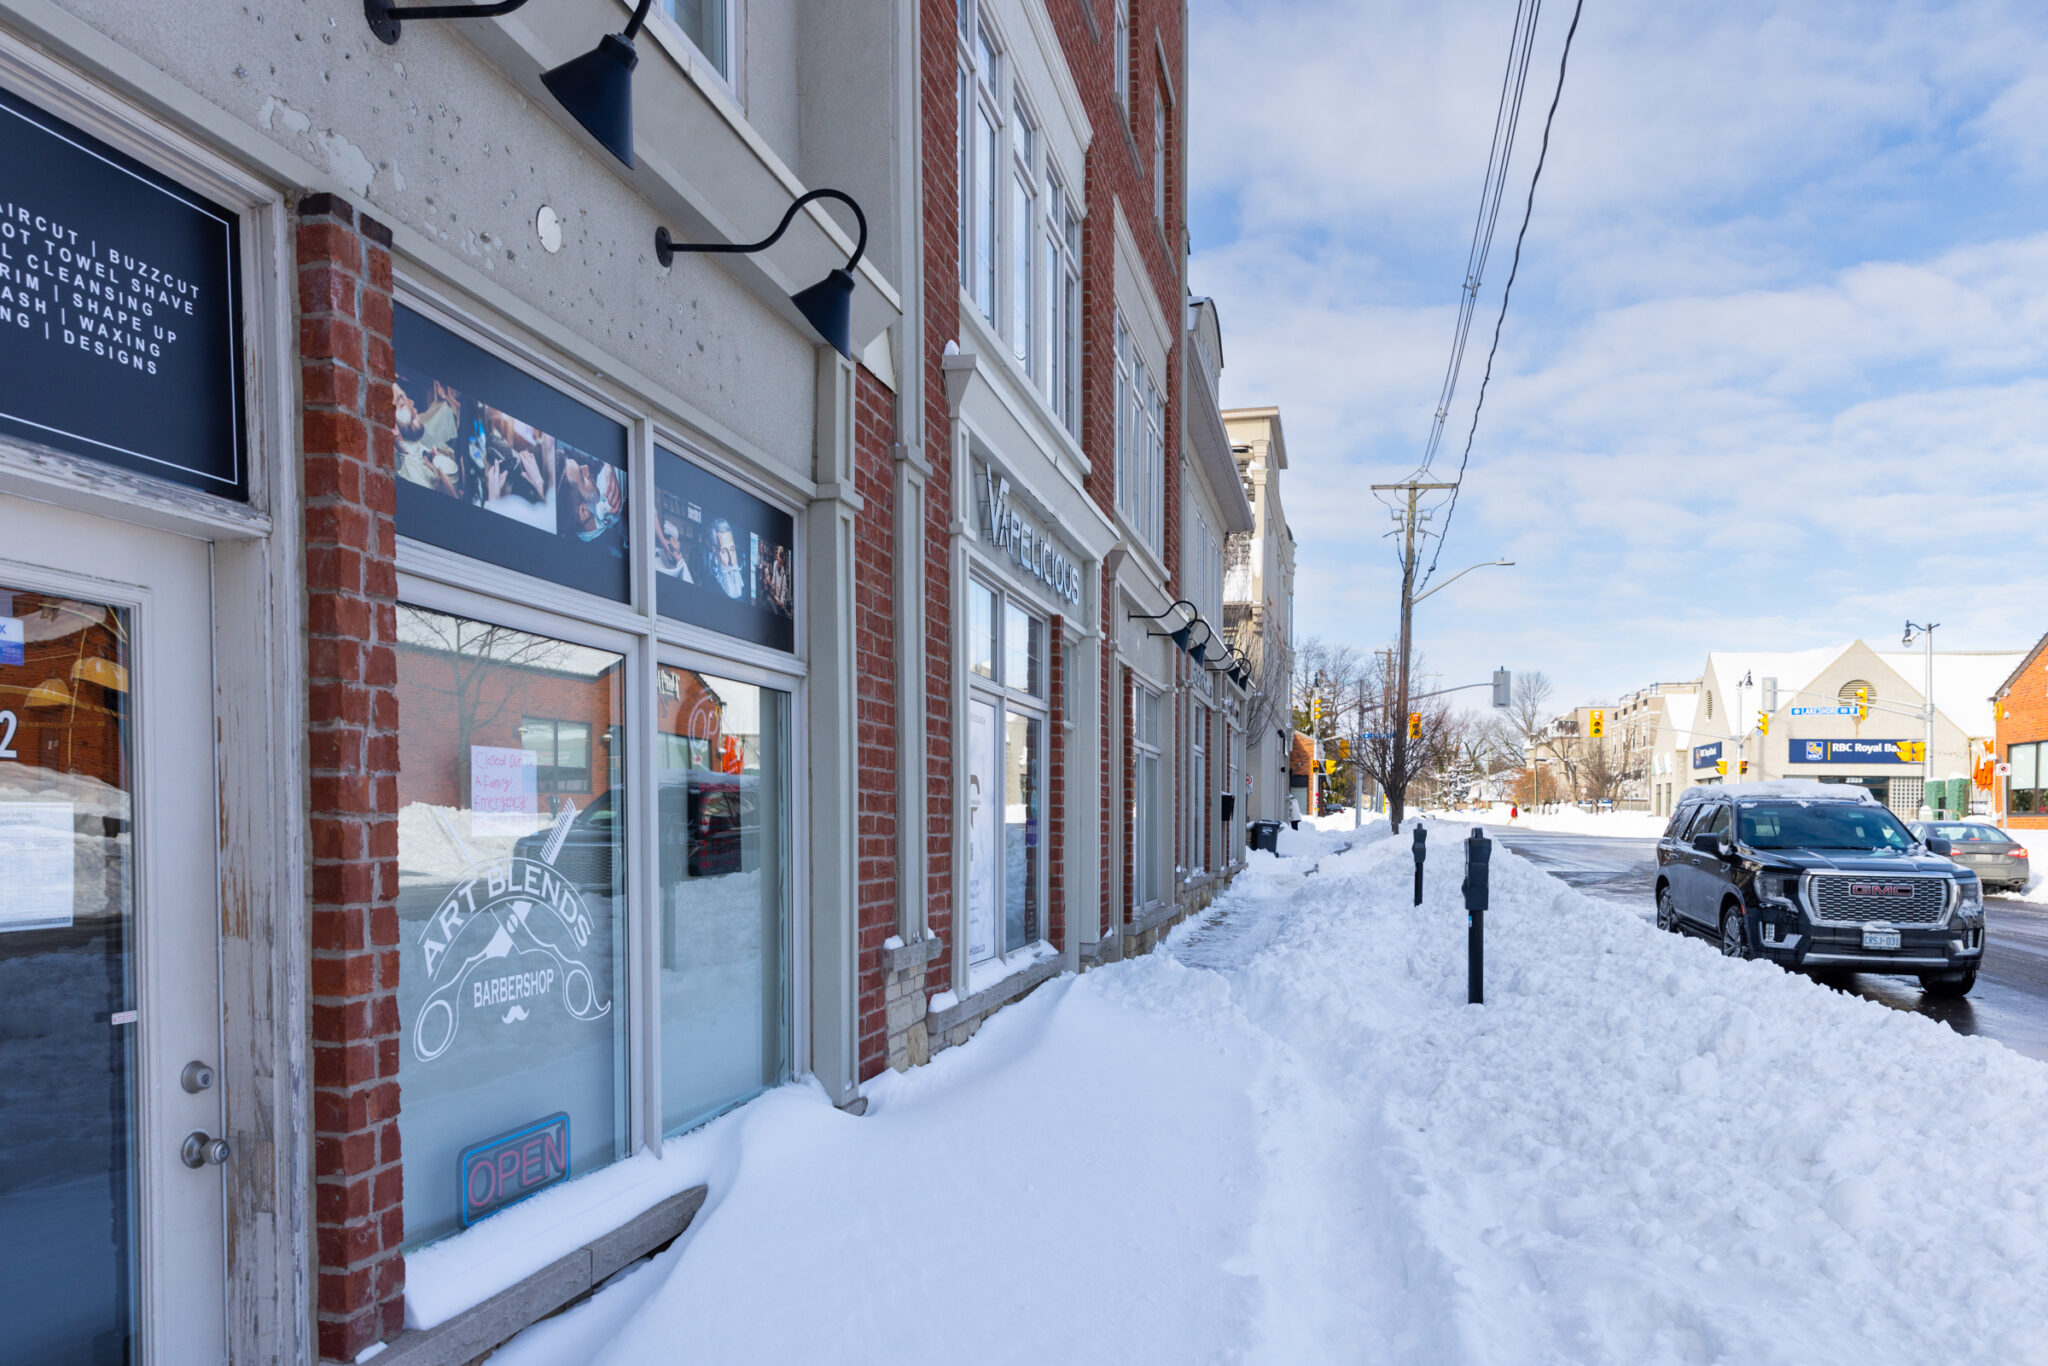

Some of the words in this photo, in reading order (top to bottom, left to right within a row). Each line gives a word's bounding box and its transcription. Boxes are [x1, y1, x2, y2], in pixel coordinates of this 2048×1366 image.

[27, 254, 153, 317] CLEANSING
[44, 240, 119, 284] TOWEL
[131, 278, 194, 316] SHAVE
[109, 248, 200, 299] BUZZCUT
[72, 293, 142, 332] SHAPE
[153, 325, 177, 344] UP
[79, 314, 161, 357] WAXING
[63, 329, 157, 375] DESIGNS
[1832, 743, 1853, 752] RBC
[1854, 743, 1882, 754] Royal
[1884, 743, 1903, 753] Ba
[483, 775, 512, 792] Family
[1852, 884, 1912, 896] GMC
[423, 879, 477, 979] ART
[487, 864, 592, 947] BLENDS
[473, 969, 554, 1008] BARBERSHOP
[468, 1129, 566, 1207] OPEN
